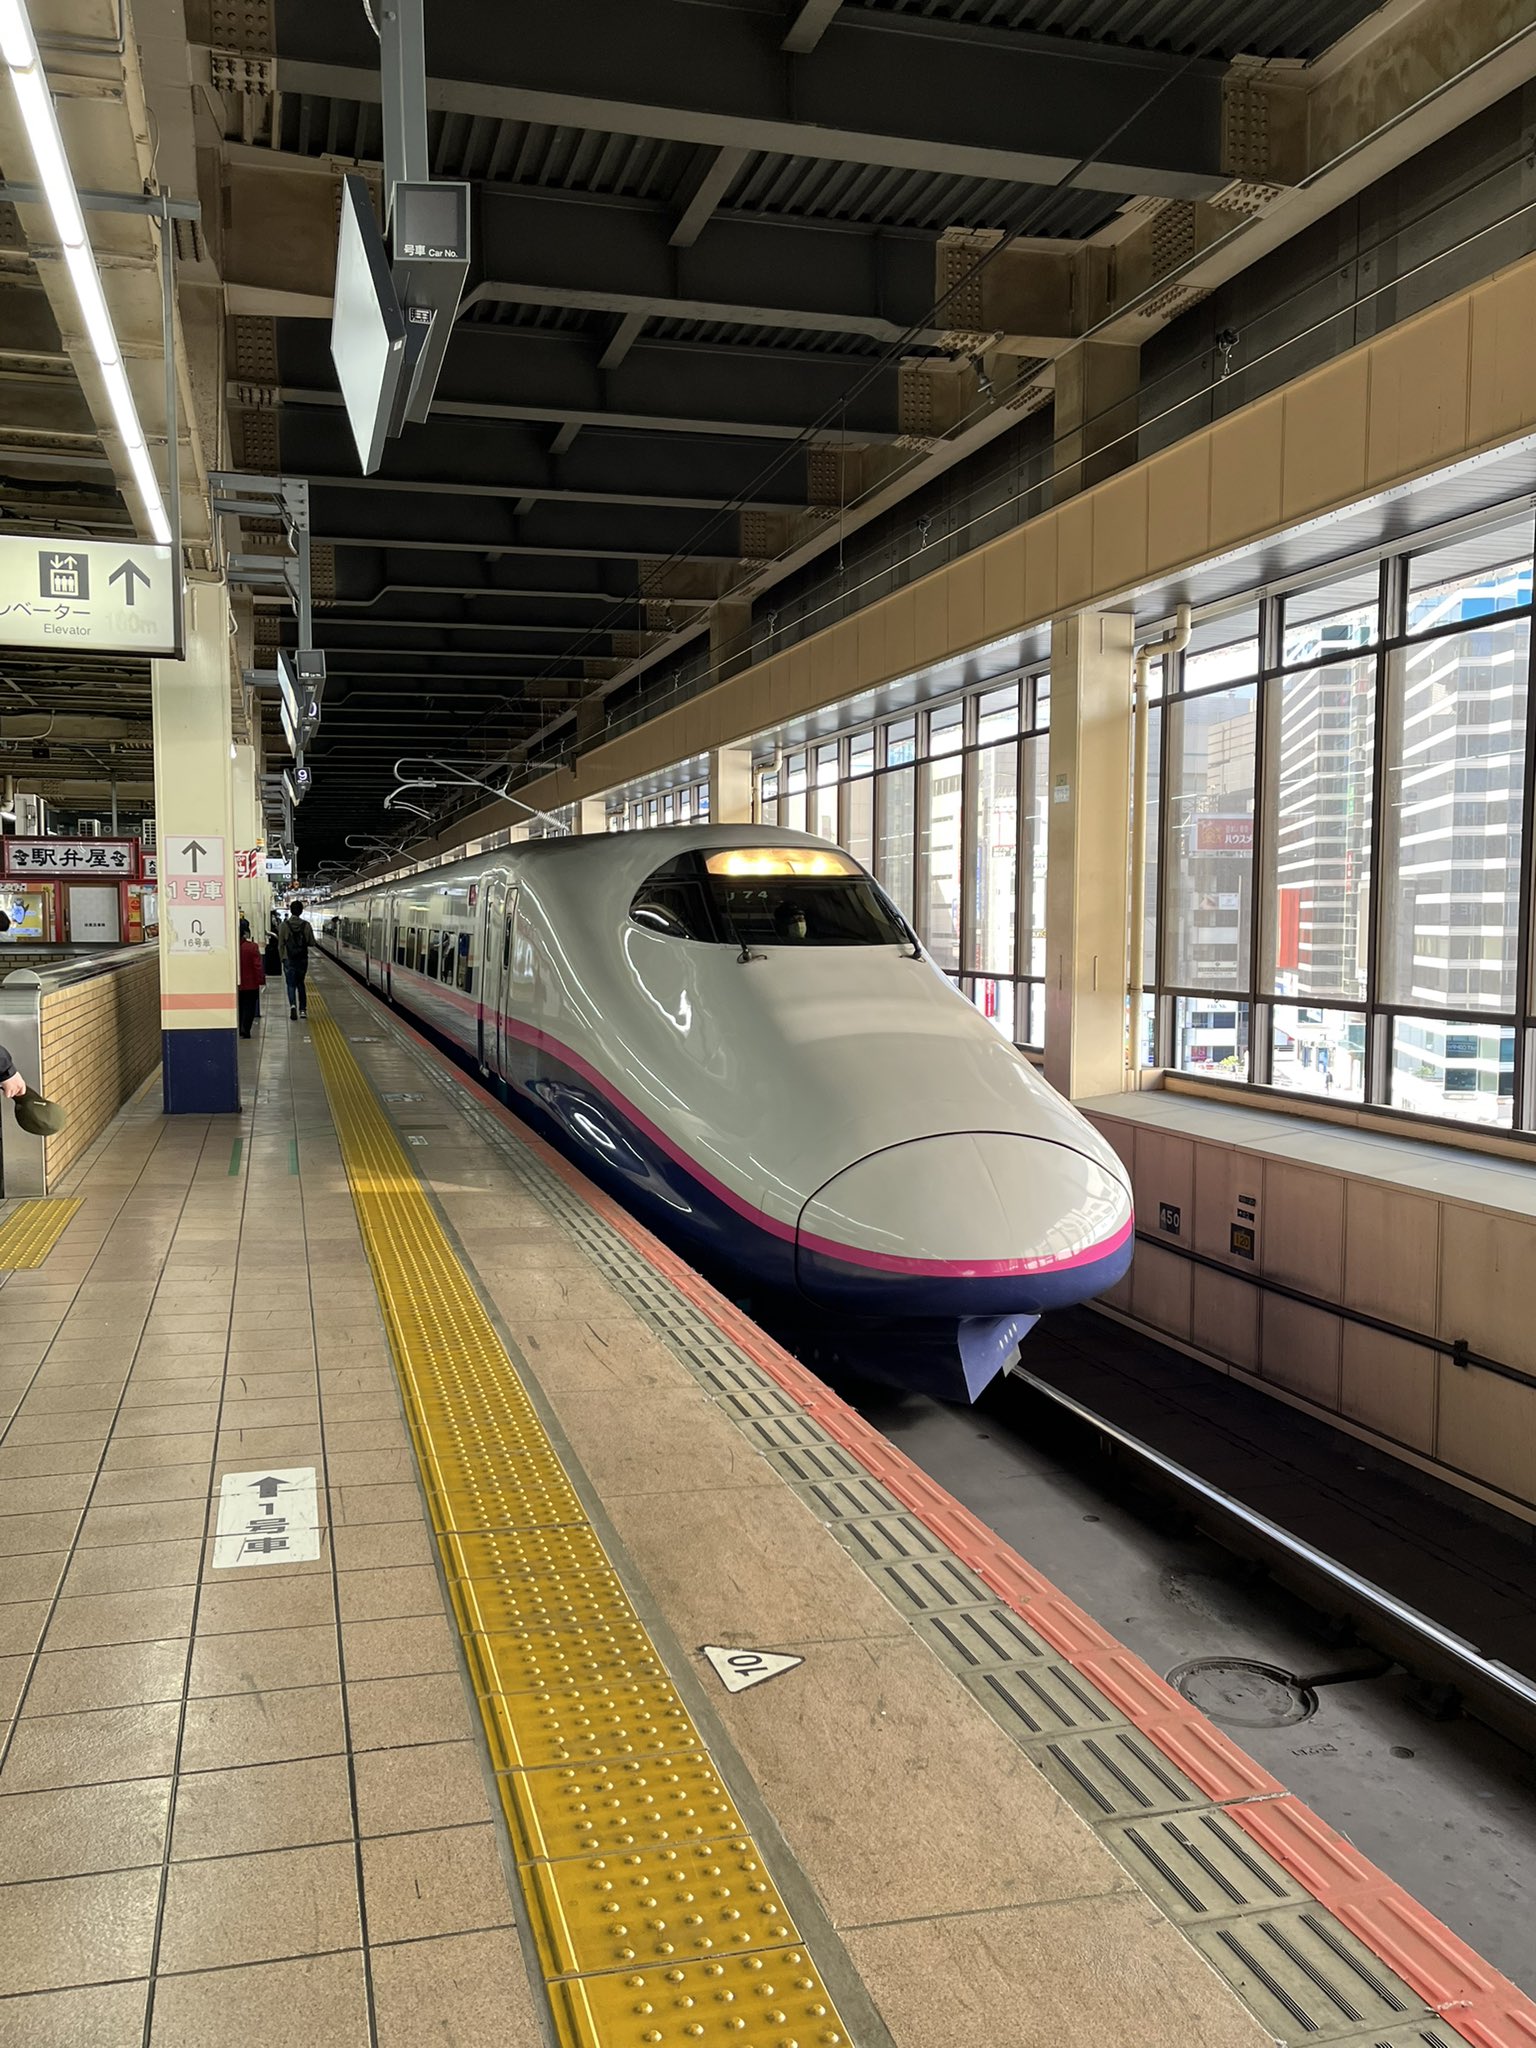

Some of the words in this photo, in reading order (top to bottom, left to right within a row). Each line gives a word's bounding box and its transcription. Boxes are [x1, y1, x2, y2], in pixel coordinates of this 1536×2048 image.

[404, 244, 426, 256] 号車
[428, 248, 443, 257] Car
[444, 249, 458, 258] No.
[44, 623, 91, 636] Elevator
[298, 769, 308, 780] 9
[31, 847, 111, 867] 駅弁屋
[168, 880, 223, 900] 1号車
[1160, 1208, 1179, 1227] 450
[244, 1503, 290, 1553] 1号車
[727, 1655, 768, 1676] 10
